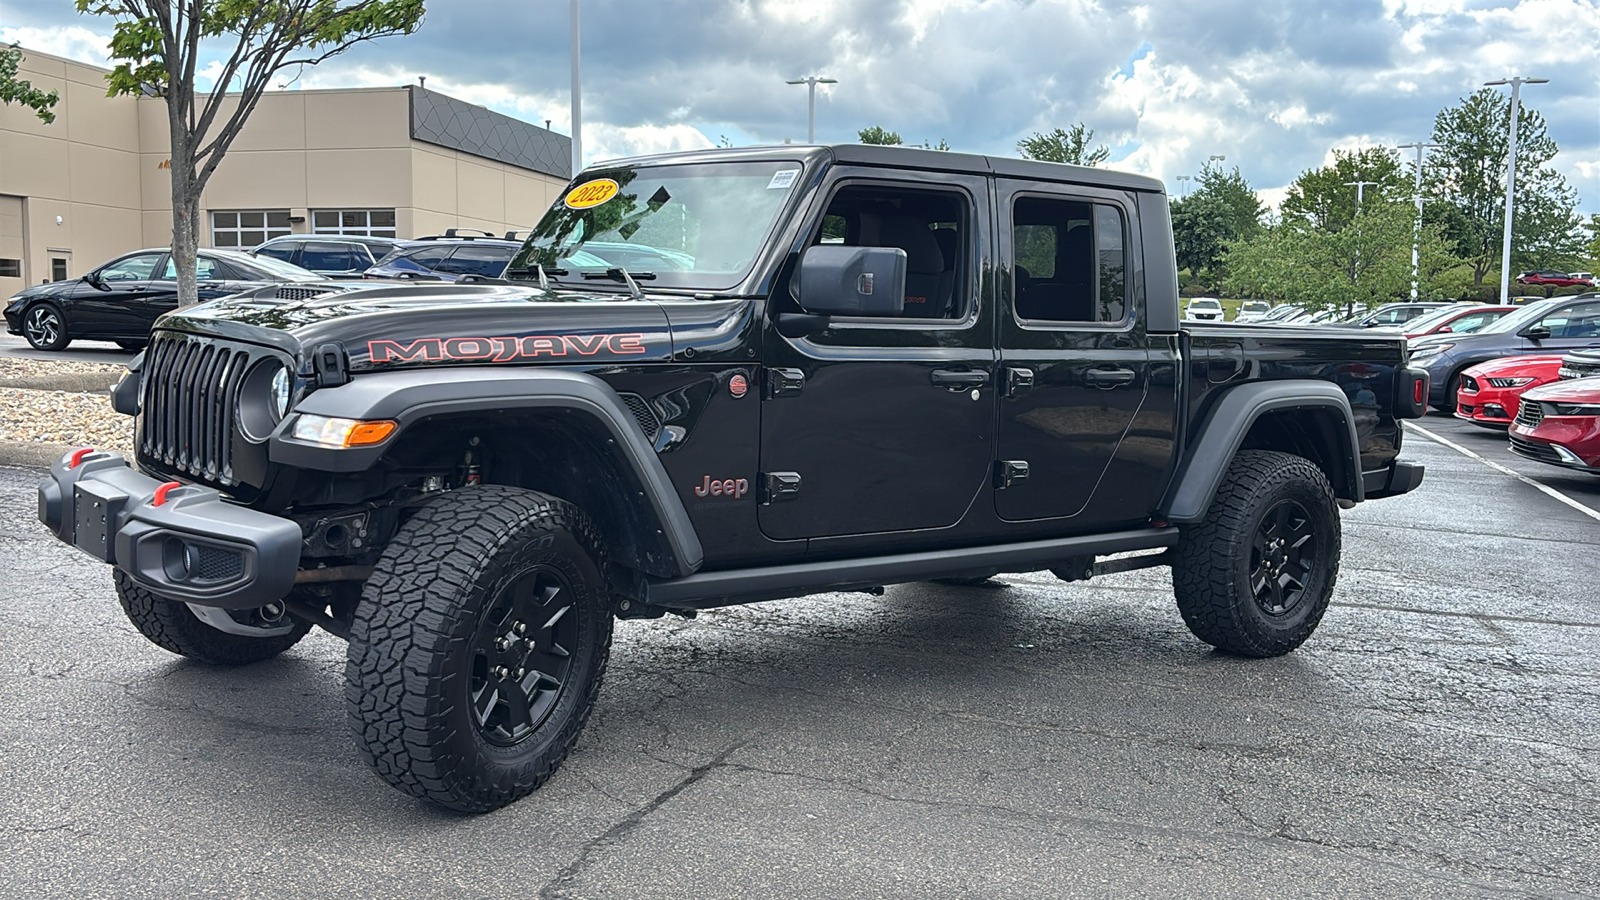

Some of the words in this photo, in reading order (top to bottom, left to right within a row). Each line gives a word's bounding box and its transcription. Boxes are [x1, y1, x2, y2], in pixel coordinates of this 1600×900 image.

[570, 185, 613, 203] 2023
[368, 333, 646, 363] MOJAVE
[694, 475, 749, 499] Jeep
